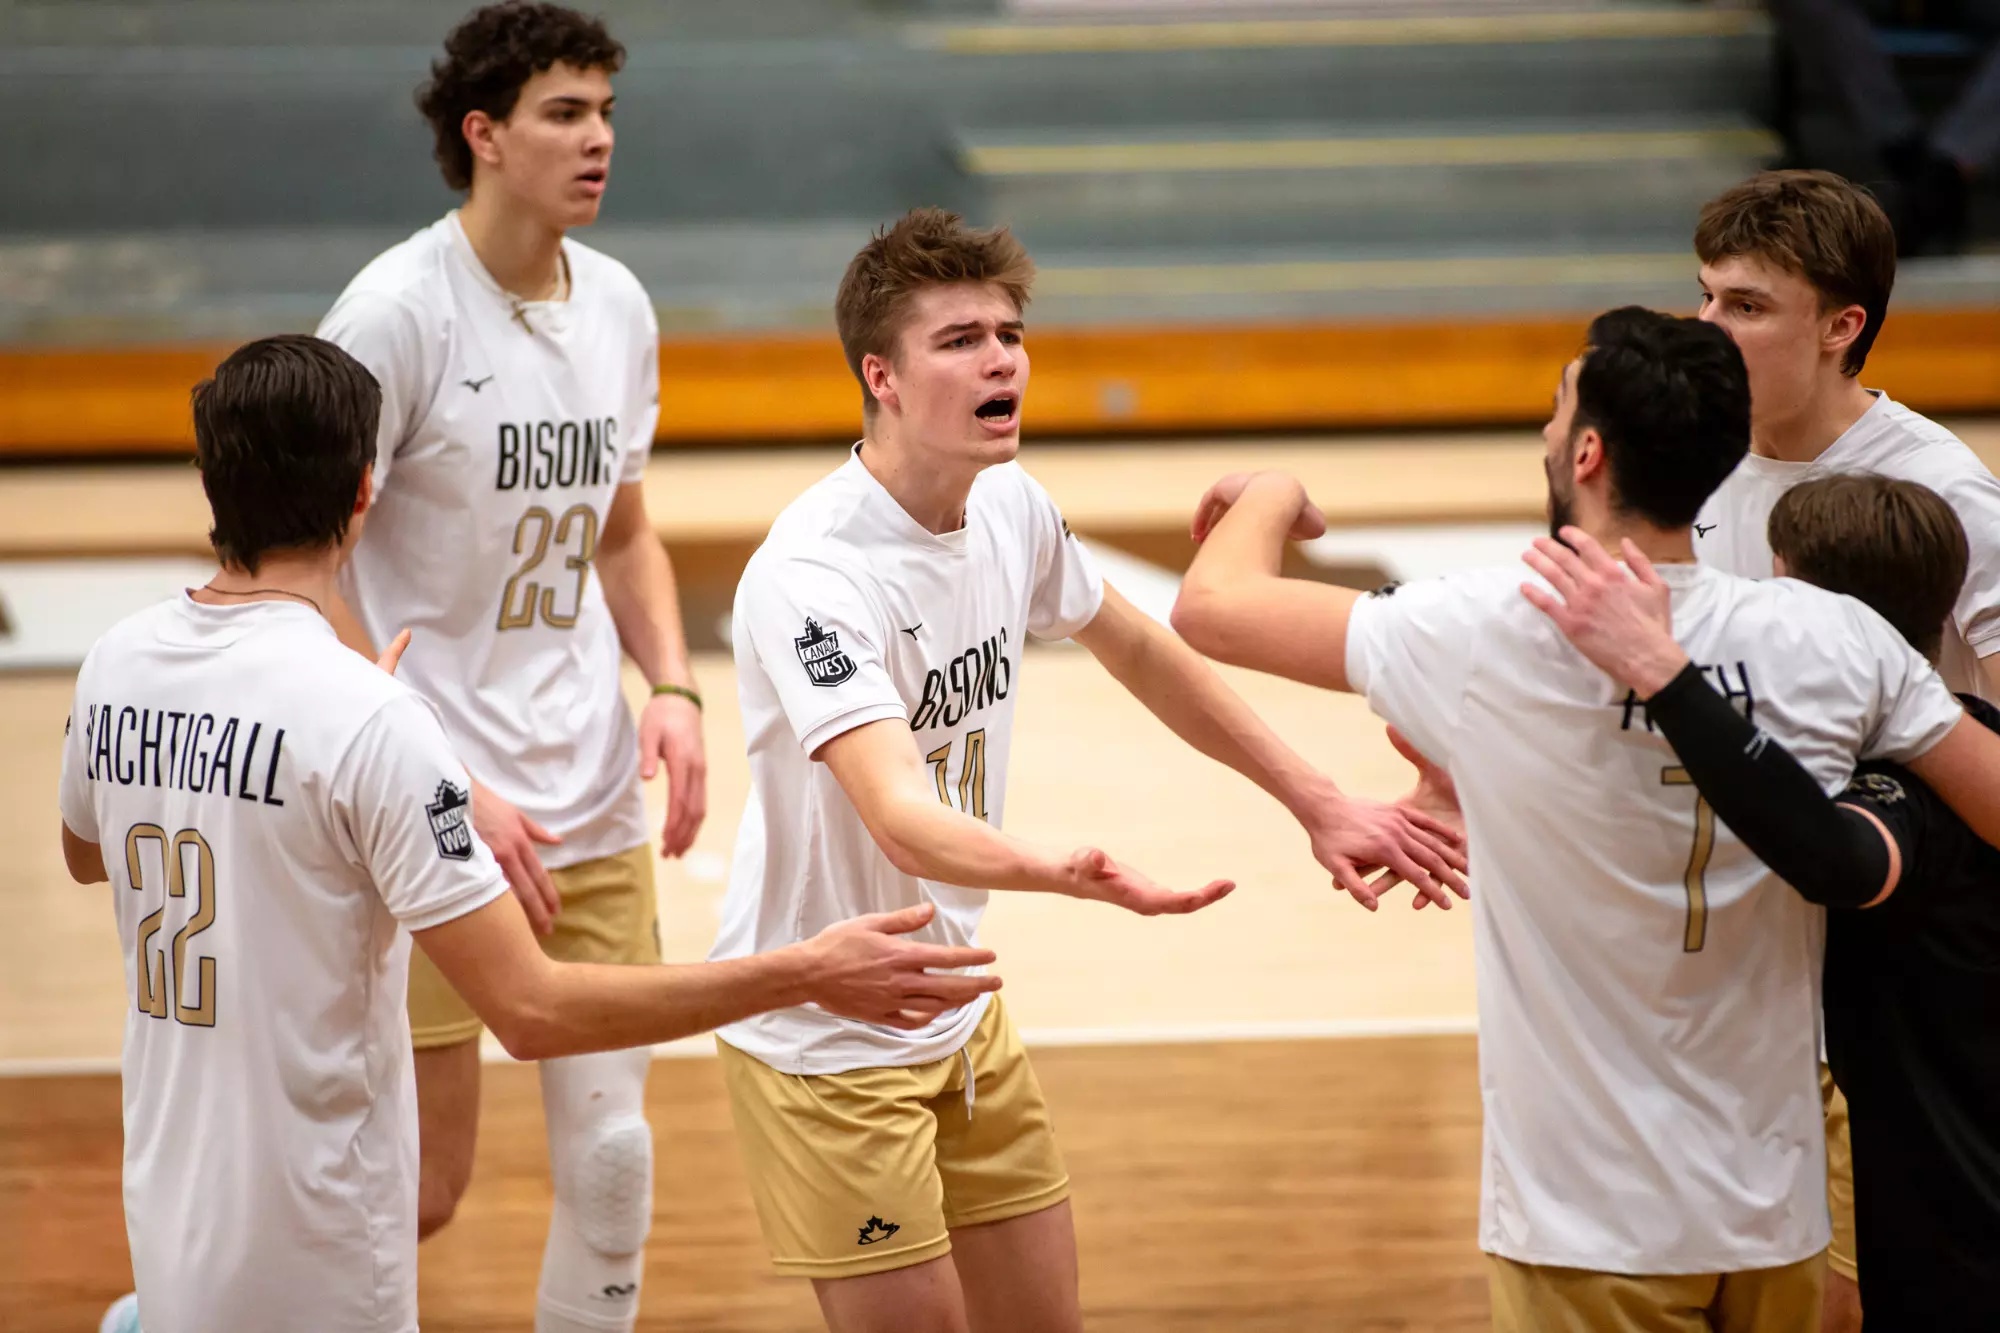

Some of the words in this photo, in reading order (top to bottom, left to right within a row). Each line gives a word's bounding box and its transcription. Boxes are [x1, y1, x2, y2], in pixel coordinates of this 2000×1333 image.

[495, 416, 618, 492] BISONS
[496, 502, 598, 632] 23
[808, 654, 849, 681] WEST
[910, 626, 1010, 732] BISONS
[926, 727, 988, 825] 14
[1661, 765, 1716, 953] 7
[125, 822, 216, 1028] 22
